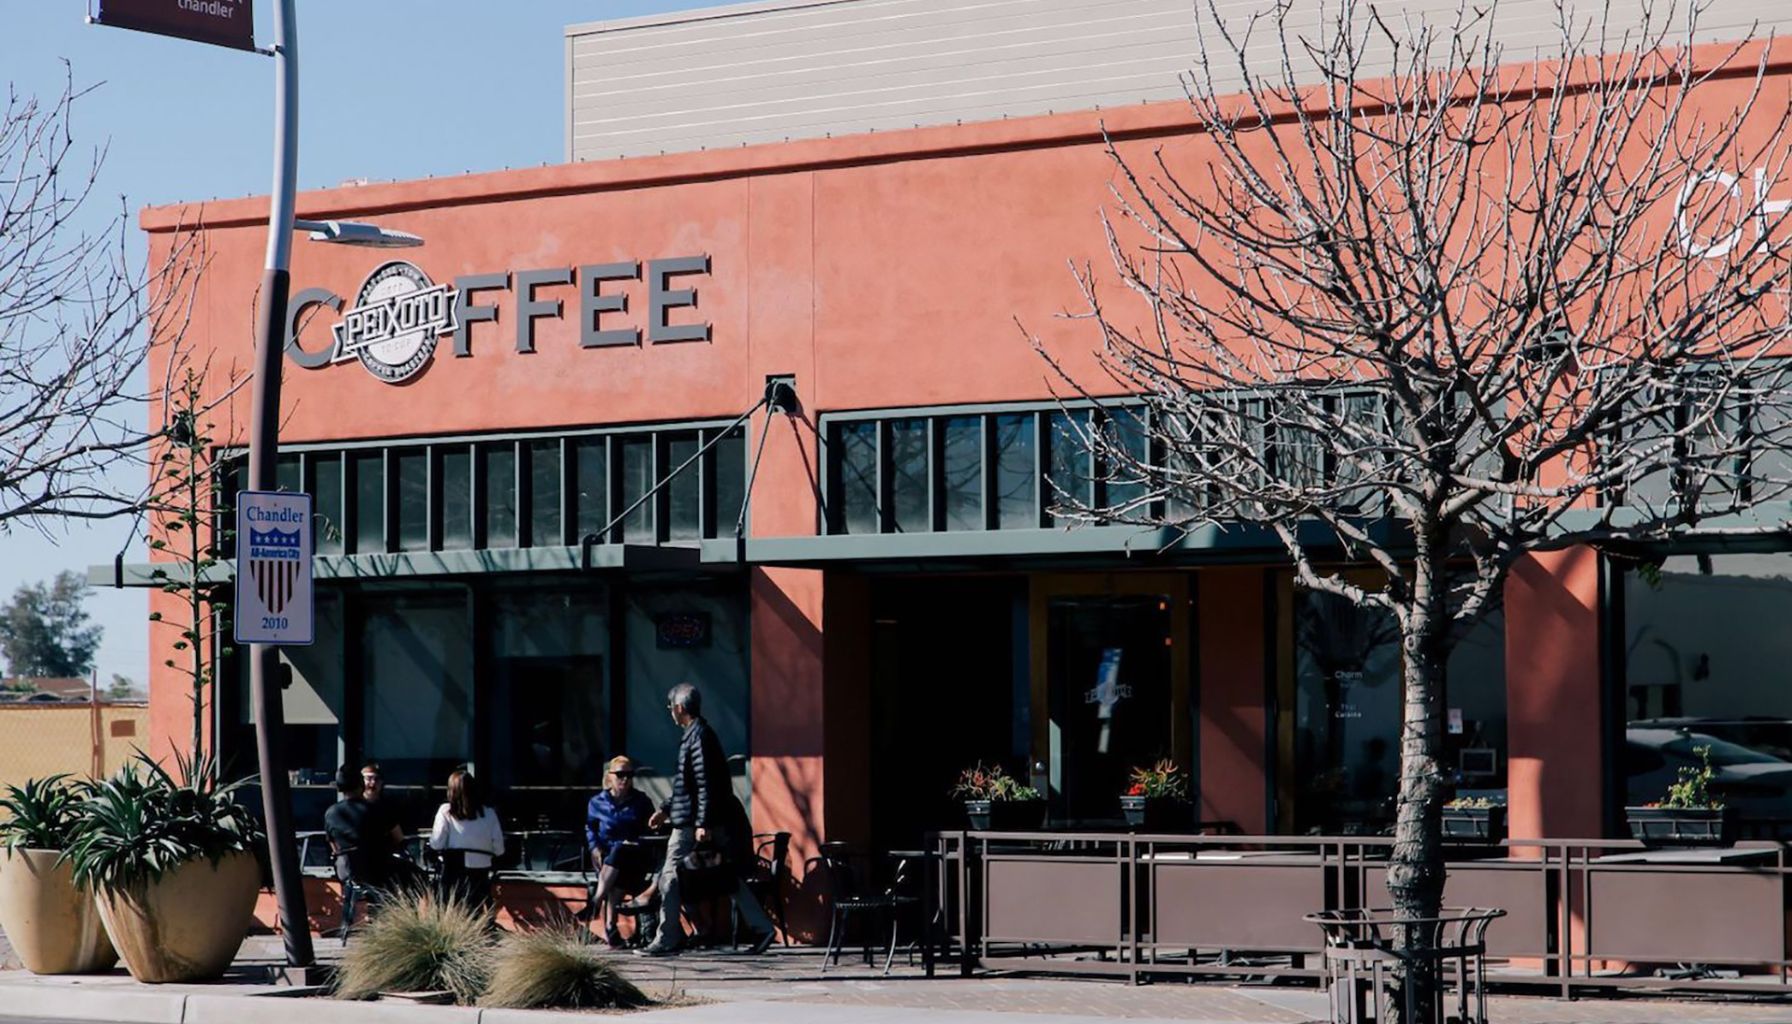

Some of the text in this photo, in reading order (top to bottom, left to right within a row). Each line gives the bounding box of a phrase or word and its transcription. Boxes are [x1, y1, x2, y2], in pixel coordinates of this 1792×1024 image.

[346, 289, 443, 344] PEIXOTO
[246, 506, 304, 523] Chandler
[262, 617, 288, 630] 2010
